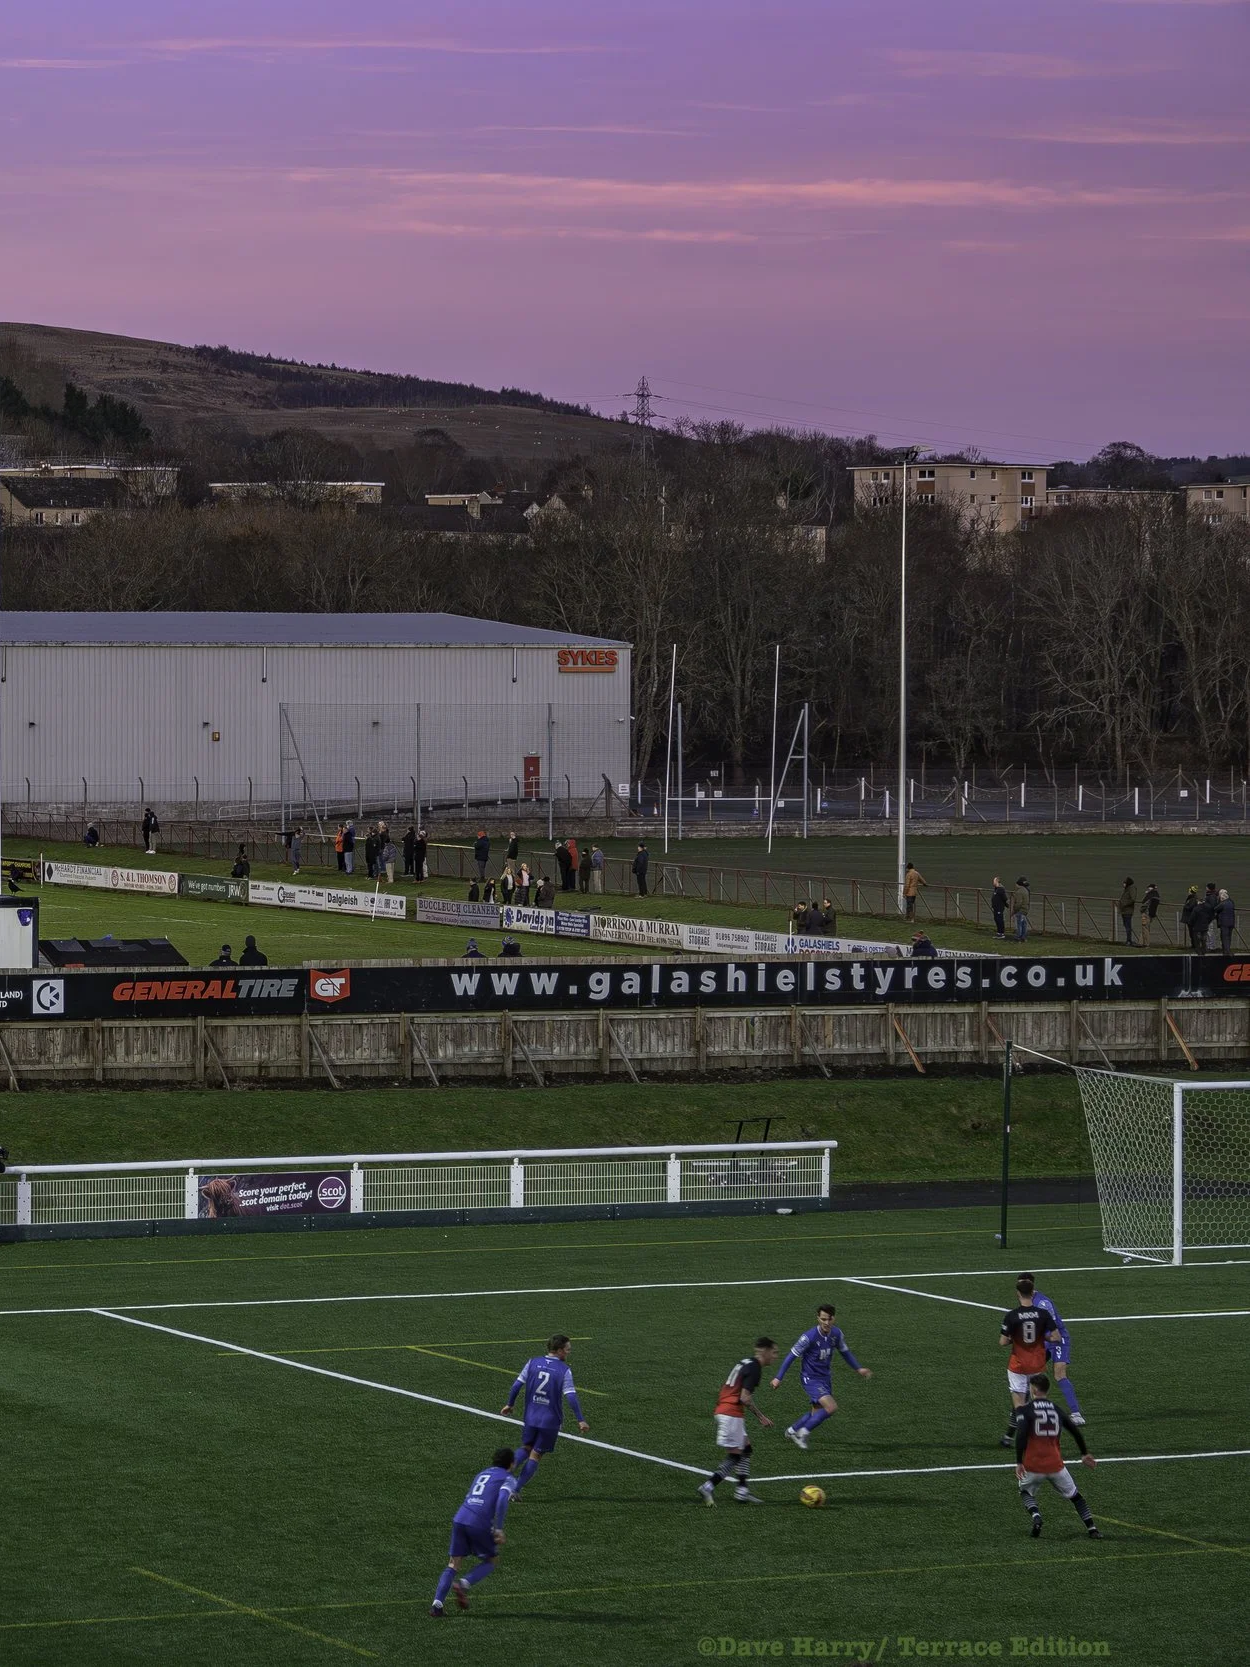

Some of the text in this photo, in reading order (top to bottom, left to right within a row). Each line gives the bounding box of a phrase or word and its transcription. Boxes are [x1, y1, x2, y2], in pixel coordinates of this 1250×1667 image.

[557, 649, 618, 666] SYKES
[54, 864, 103, 876] McHARDY FINANCIAL
[137, 873, 167, 885] THOMSON
[188, 880, 226, 892] We've got numbers
[228, 884, 241, 898] JRW
[327, 892, 358, 907] Dalgleish
[419, 899, 500, 916] BUCCLEUCH CLEANERS
[593, 928, 634, 942] (ENGINEERING)
[634, 933, 646, 942] LTD
[638, 921, 644, 933] &
[645, 921, 681, 937] MURRAY
[689, 927, 710, 936] GALASHIELS
[688, 935, 710, 946] STORAGE
[754, 933, 777, 943] GALASHIELS
[799, 938, 840, 951] GALASHIELS
[754, 941, 777, 953] STORAGE
[450, 957, 1124, 1000] www.galashielstyres.co.uk
[315, 977, 346, 997] GT
[238, 1181, 307, 1198] Score your perfect
[319, 1185, 343, 1197] .scot
[239, 1189, 313, 1207] .scot domain today!
[266, 1201, 303, 1212] visit dot.scot
[1022, 1321, 1036, 1344] 8
[535, 1370, 550, 1395] 2
[1033, 1409, 1060, 1437] 23
[471, 1474, 491, 1496] 8
